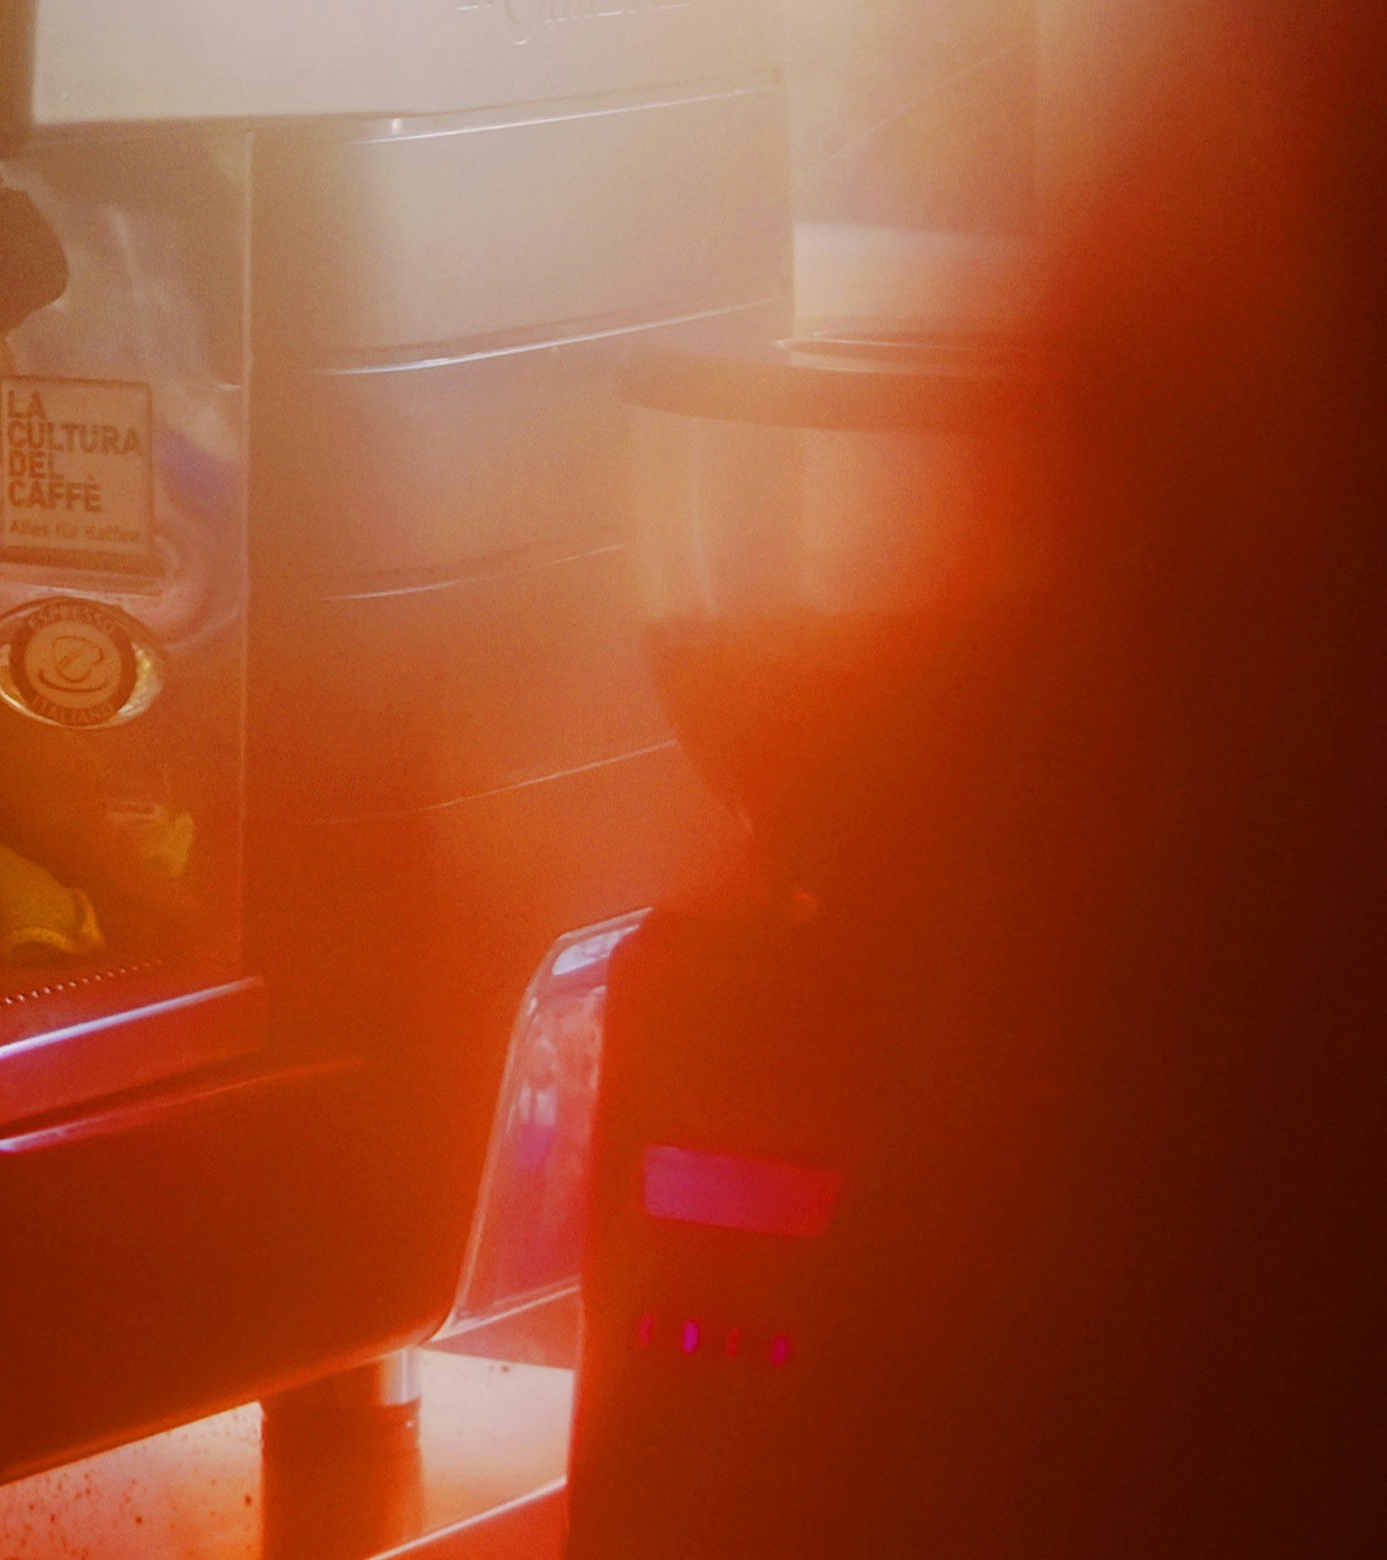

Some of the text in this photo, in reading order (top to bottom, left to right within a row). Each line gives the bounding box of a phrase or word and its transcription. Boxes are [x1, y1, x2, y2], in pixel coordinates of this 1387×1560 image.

[8, 389, 46, 420] LA
[8, 420, 144, 456] CULTURA
[8, 449, 65, 480] DEL
